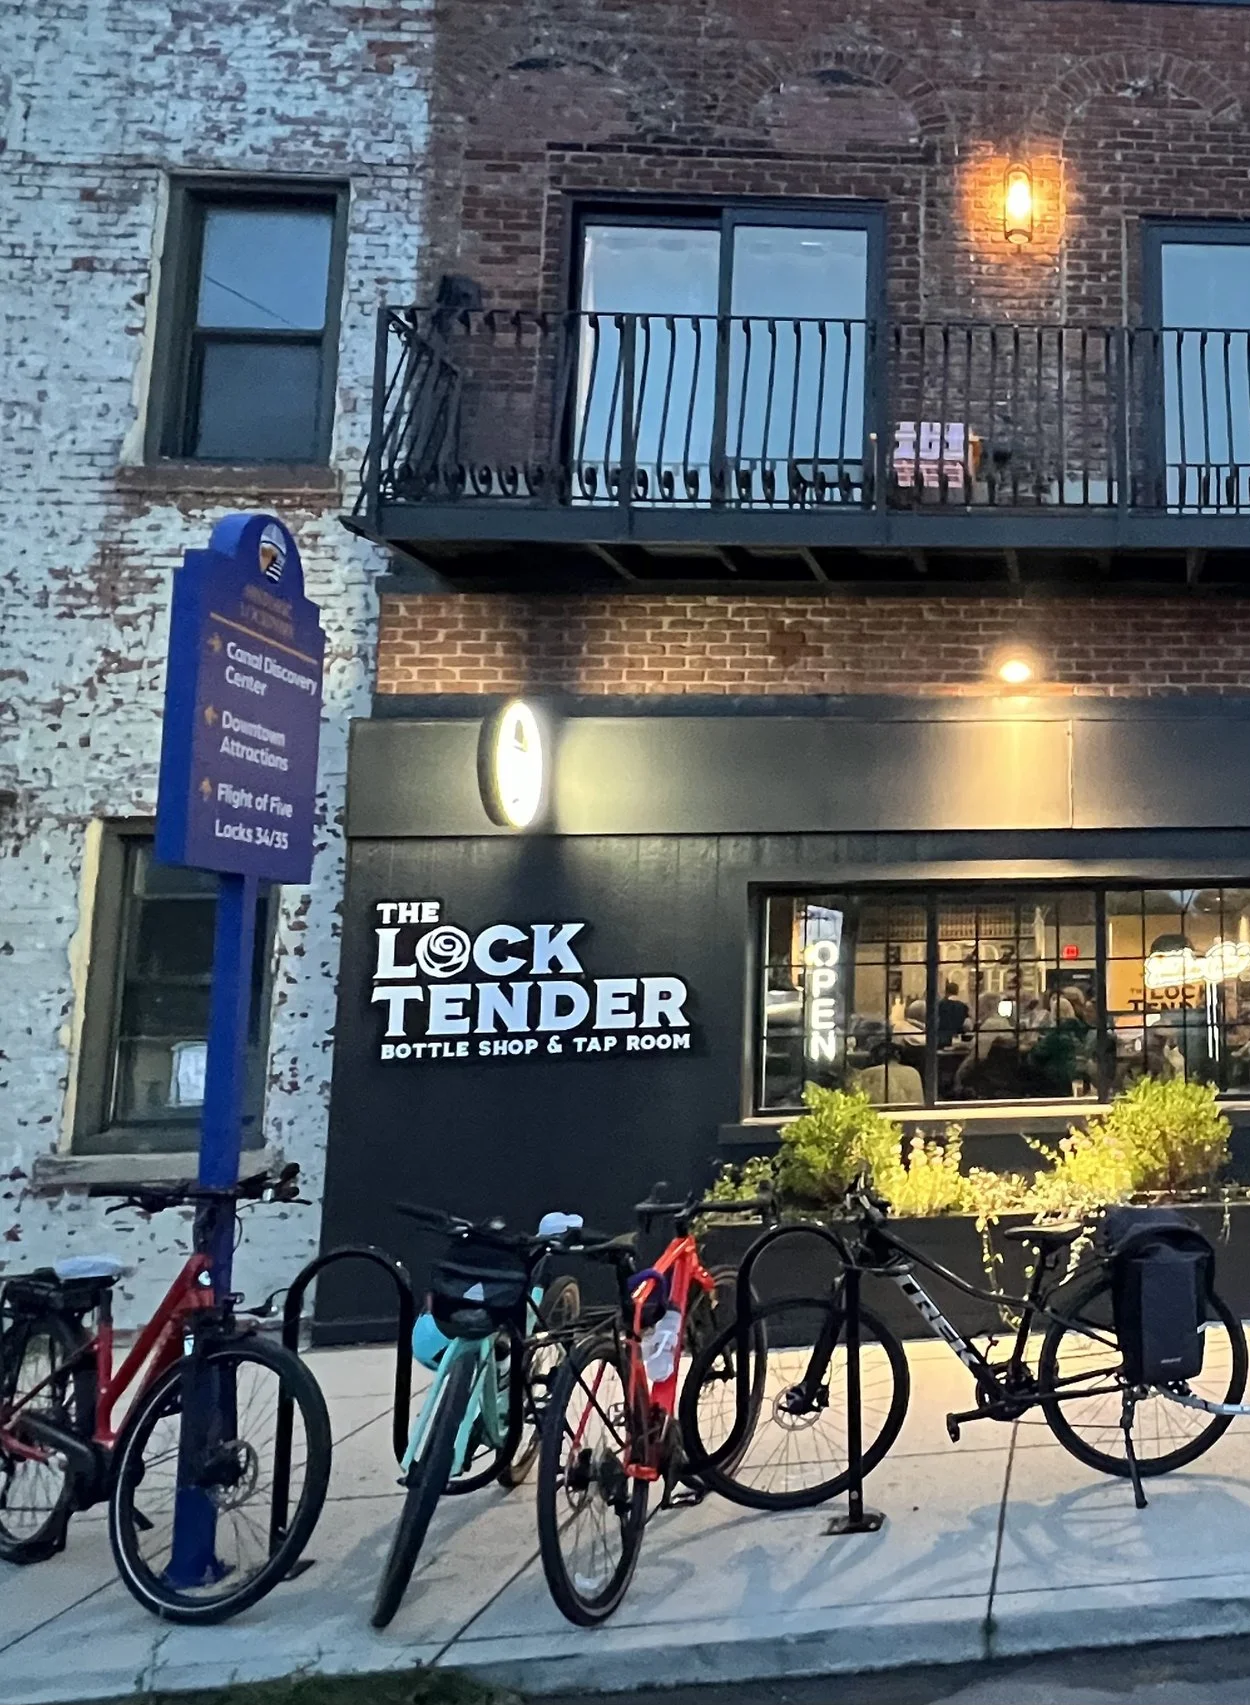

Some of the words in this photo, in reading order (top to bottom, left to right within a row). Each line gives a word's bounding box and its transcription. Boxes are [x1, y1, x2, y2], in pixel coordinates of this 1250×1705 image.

[226, 665, 267, 696] Center
[227, 642, 263, 671] Canal
[264, 656, 318, 696] Discovery
[222, 710, 286, 747] Downtown
[220, 736, 288, 771] Attractions
[217, 783, 253, 809] Flight
[255, 793, 269, 811] of
[269, 796, 293, 818] Five
[215, 819, 253, 843] Locks
[255, 827, 288, 849] 34/35
[376, 901, 440, 925] THE
[372, 923, 586, 979] LOCK
[371, 976, 691, 1037] TENDER
[811, 940, 838, 1062] OPEN
[1151, 983, 1206, 1000] LOC
[380, 1041, 470, 1060] BOTTLE
[478, 1038, 539, 1056] SHOP
[546, 1035, 563, 1054] &
[573, 1036, 618, 1053] TAP
[626, 1033, 691, 1051] ROOM
[895, 1273, 981, 1367] TREK
